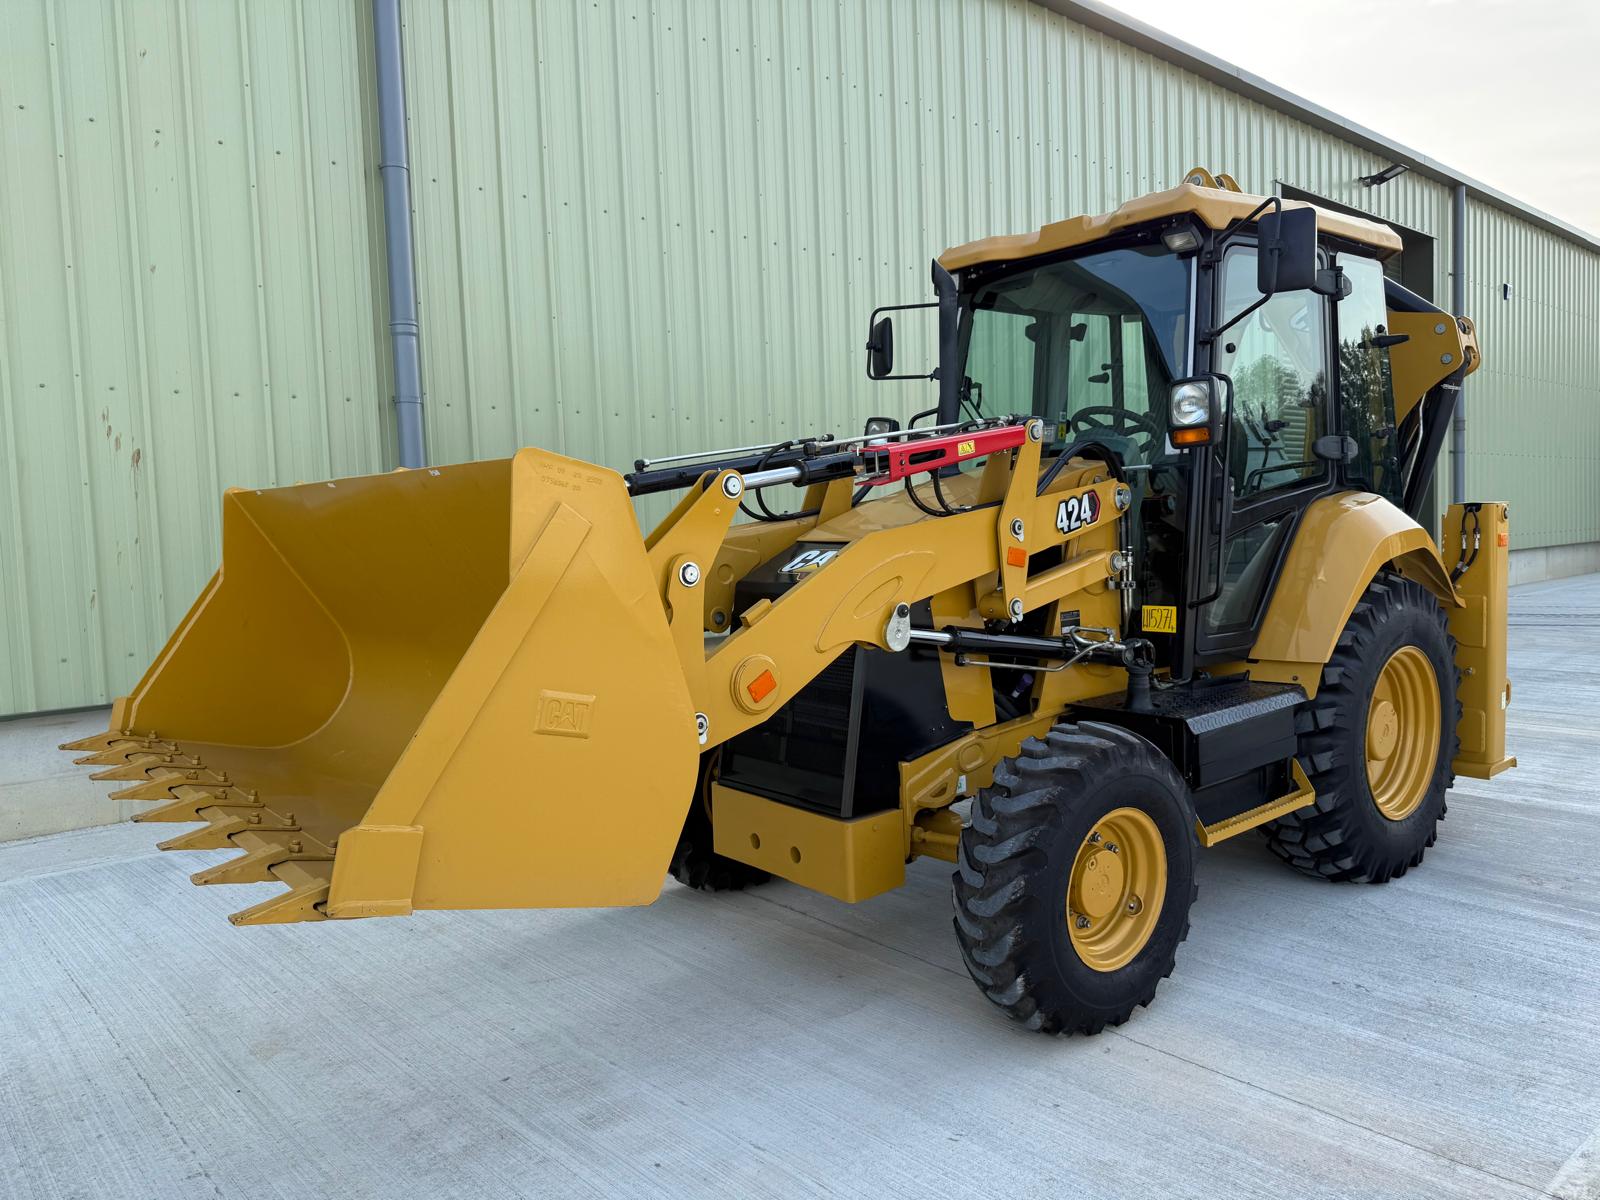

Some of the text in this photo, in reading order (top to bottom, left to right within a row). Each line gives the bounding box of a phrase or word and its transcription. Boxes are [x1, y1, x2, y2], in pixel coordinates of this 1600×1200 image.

[1056, 492, 1092, 533] 424
[781, 550, 839, 572] CA
[544, 699, 590, 732] CAT
